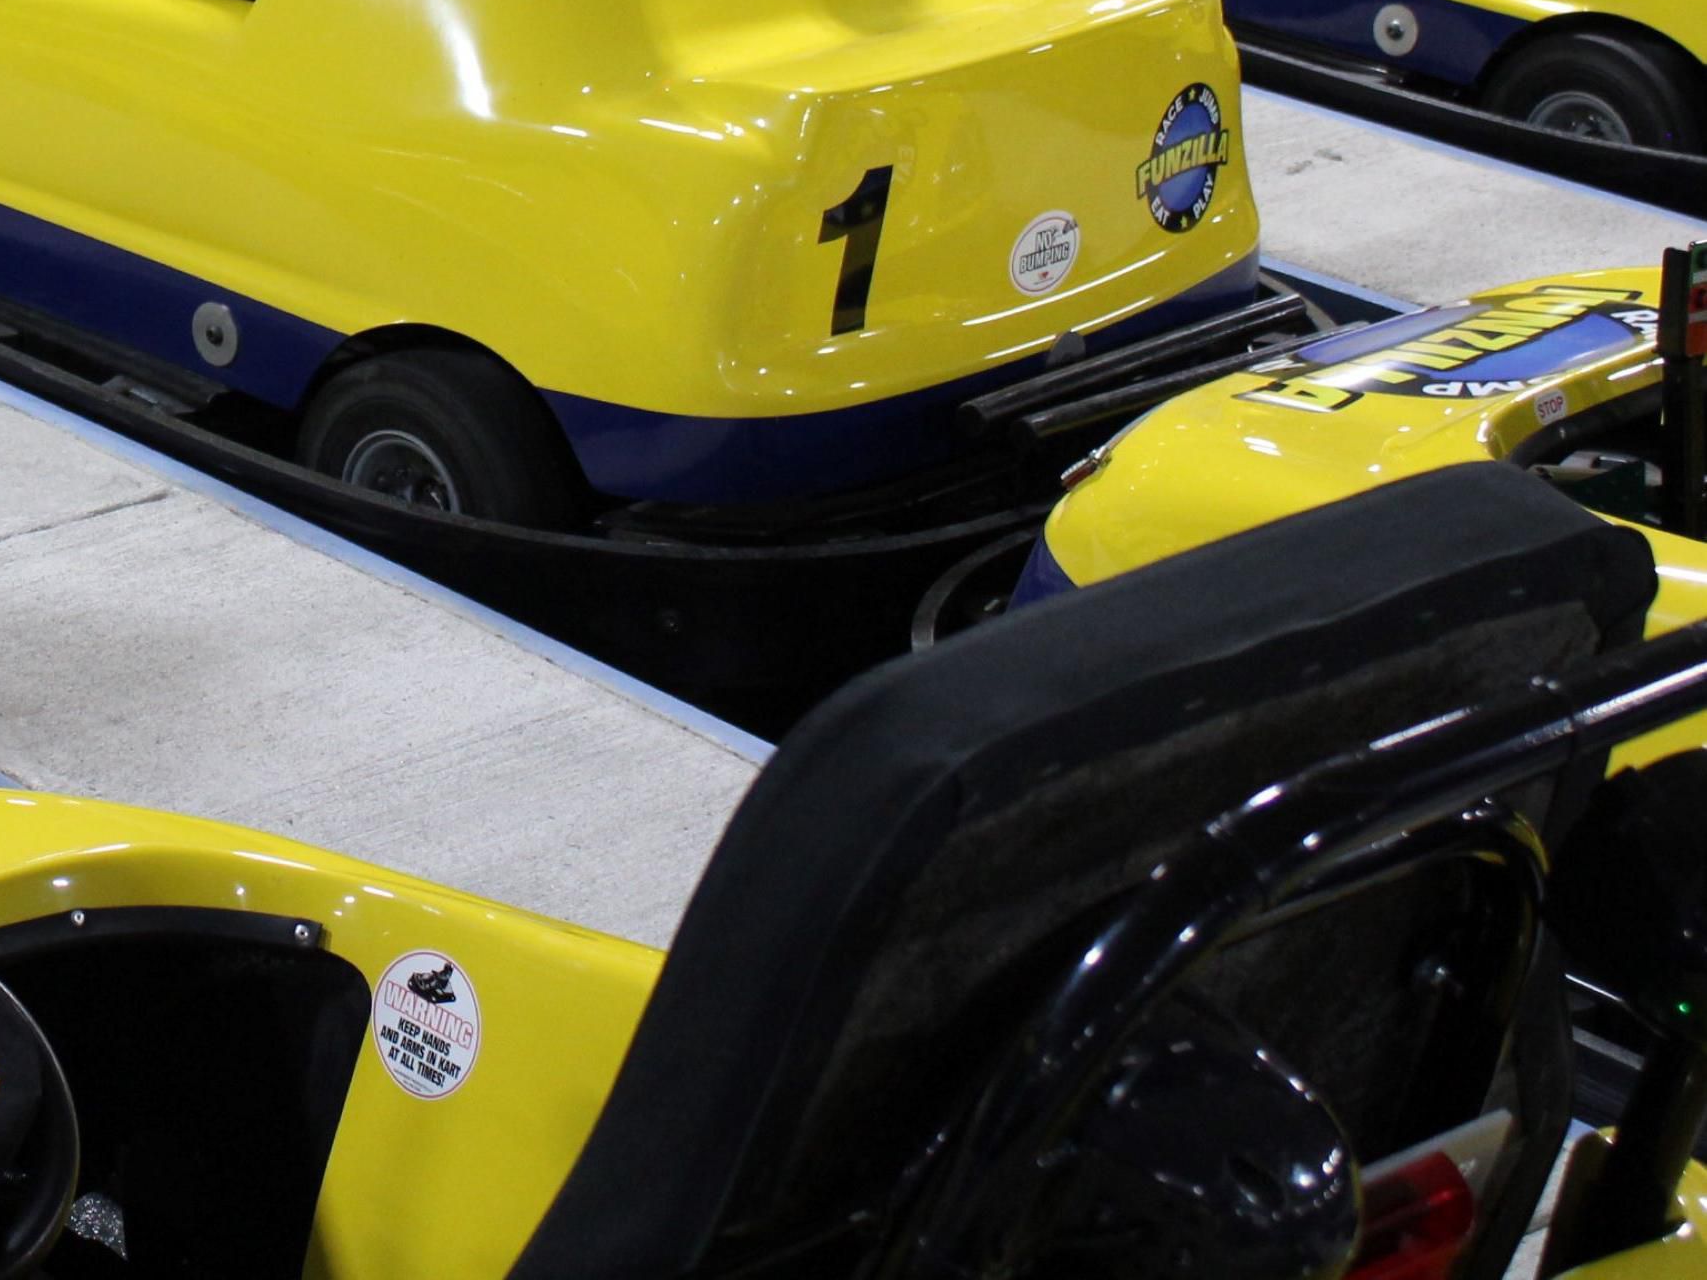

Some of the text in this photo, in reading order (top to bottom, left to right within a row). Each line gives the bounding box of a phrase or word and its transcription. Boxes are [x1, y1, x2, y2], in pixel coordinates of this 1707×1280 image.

[1156, 95, 1184, 147] RACE
[1199, 87, 1219, 124] JUMP
[1136, 129, 1229, 200] FUNZILLA
[1151, 196, 1172, 226] EAT
[1192, 173, 1214, 220] PLAY
[817, 164, 894, 337] 1
[1019, 241, 1070, 274] BUMPING
[1036, 229, 1054, 251] NO
[1537, 396, 1565, 420] STOP
[384, 980, 473, 1050] WARNING
[380, 1025, 461, 1080] AND ARMS IN KART
[397, 1017, 451, 1056] KEEP HANDS
[388, 1046, 399, 1062] AT
[400, 1053, 415, 1071] ALL
[417, 1061, 446, 1088] TIMES!
